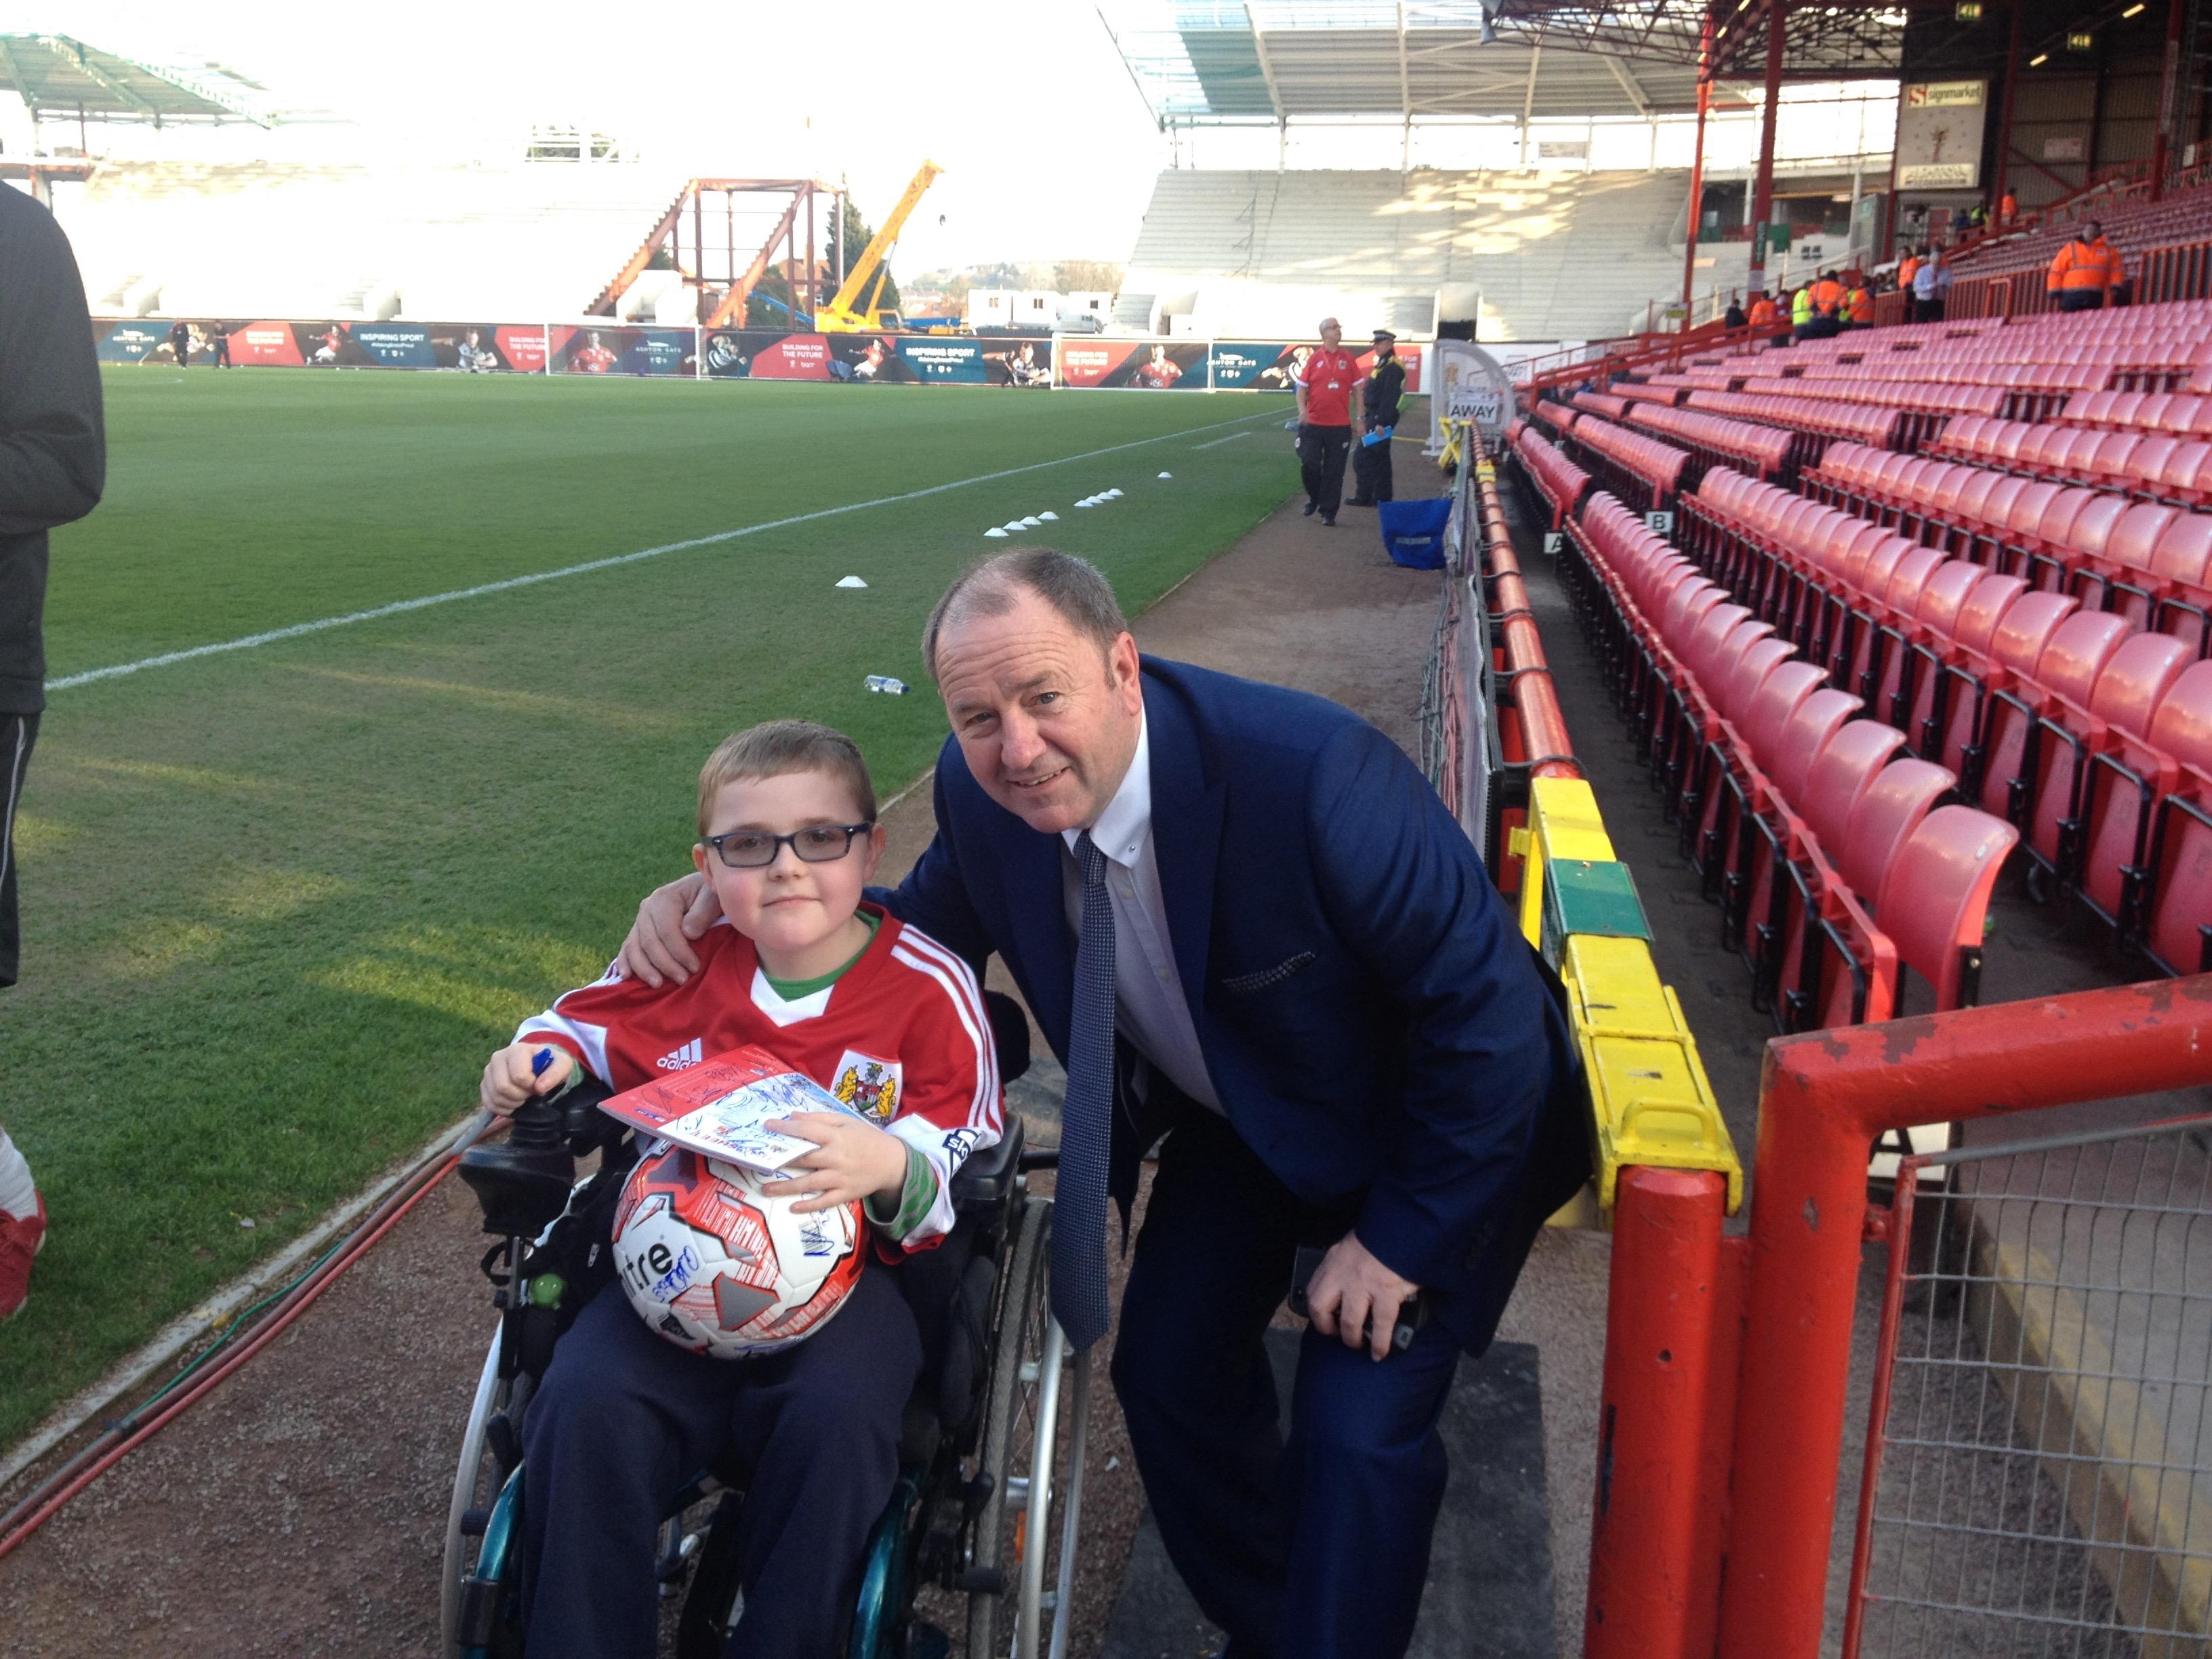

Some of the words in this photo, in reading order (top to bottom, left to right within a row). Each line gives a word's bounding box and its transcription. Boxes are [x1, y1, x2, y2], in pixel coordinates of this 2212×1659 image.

[1450, 405, 1496, 417] AWAY
[1653, 514, 1666, 529] B
[656, 1056, 698, 1071] adid
